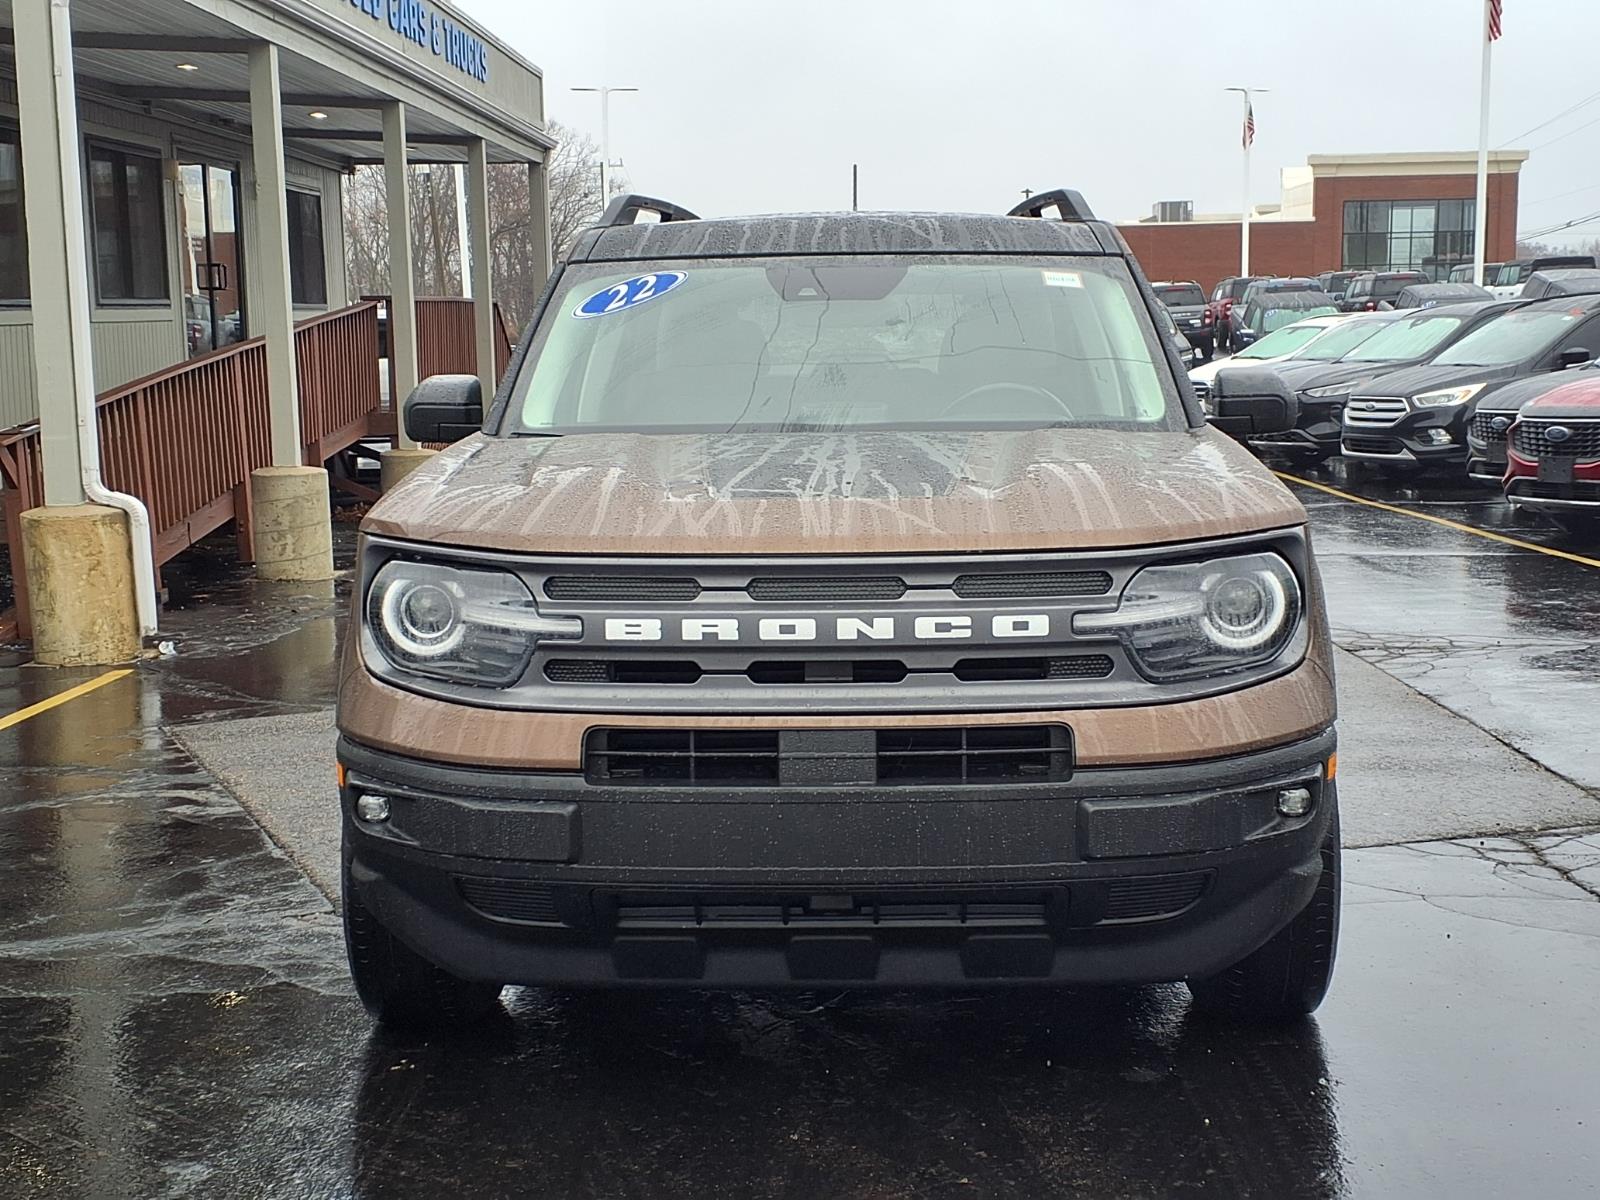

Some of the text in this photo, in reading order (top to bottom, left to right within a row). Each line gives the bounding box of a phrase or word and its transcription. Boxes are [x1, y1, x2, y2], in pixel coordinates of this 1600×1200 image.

[386, 0, 428, 47] CARS
[430, 11, 441, 56] &
[442, 18, 487, 84] TRUCKS
[604, 274, 657, 312] 22
[604, 614, 1050, 641] BRONCO
